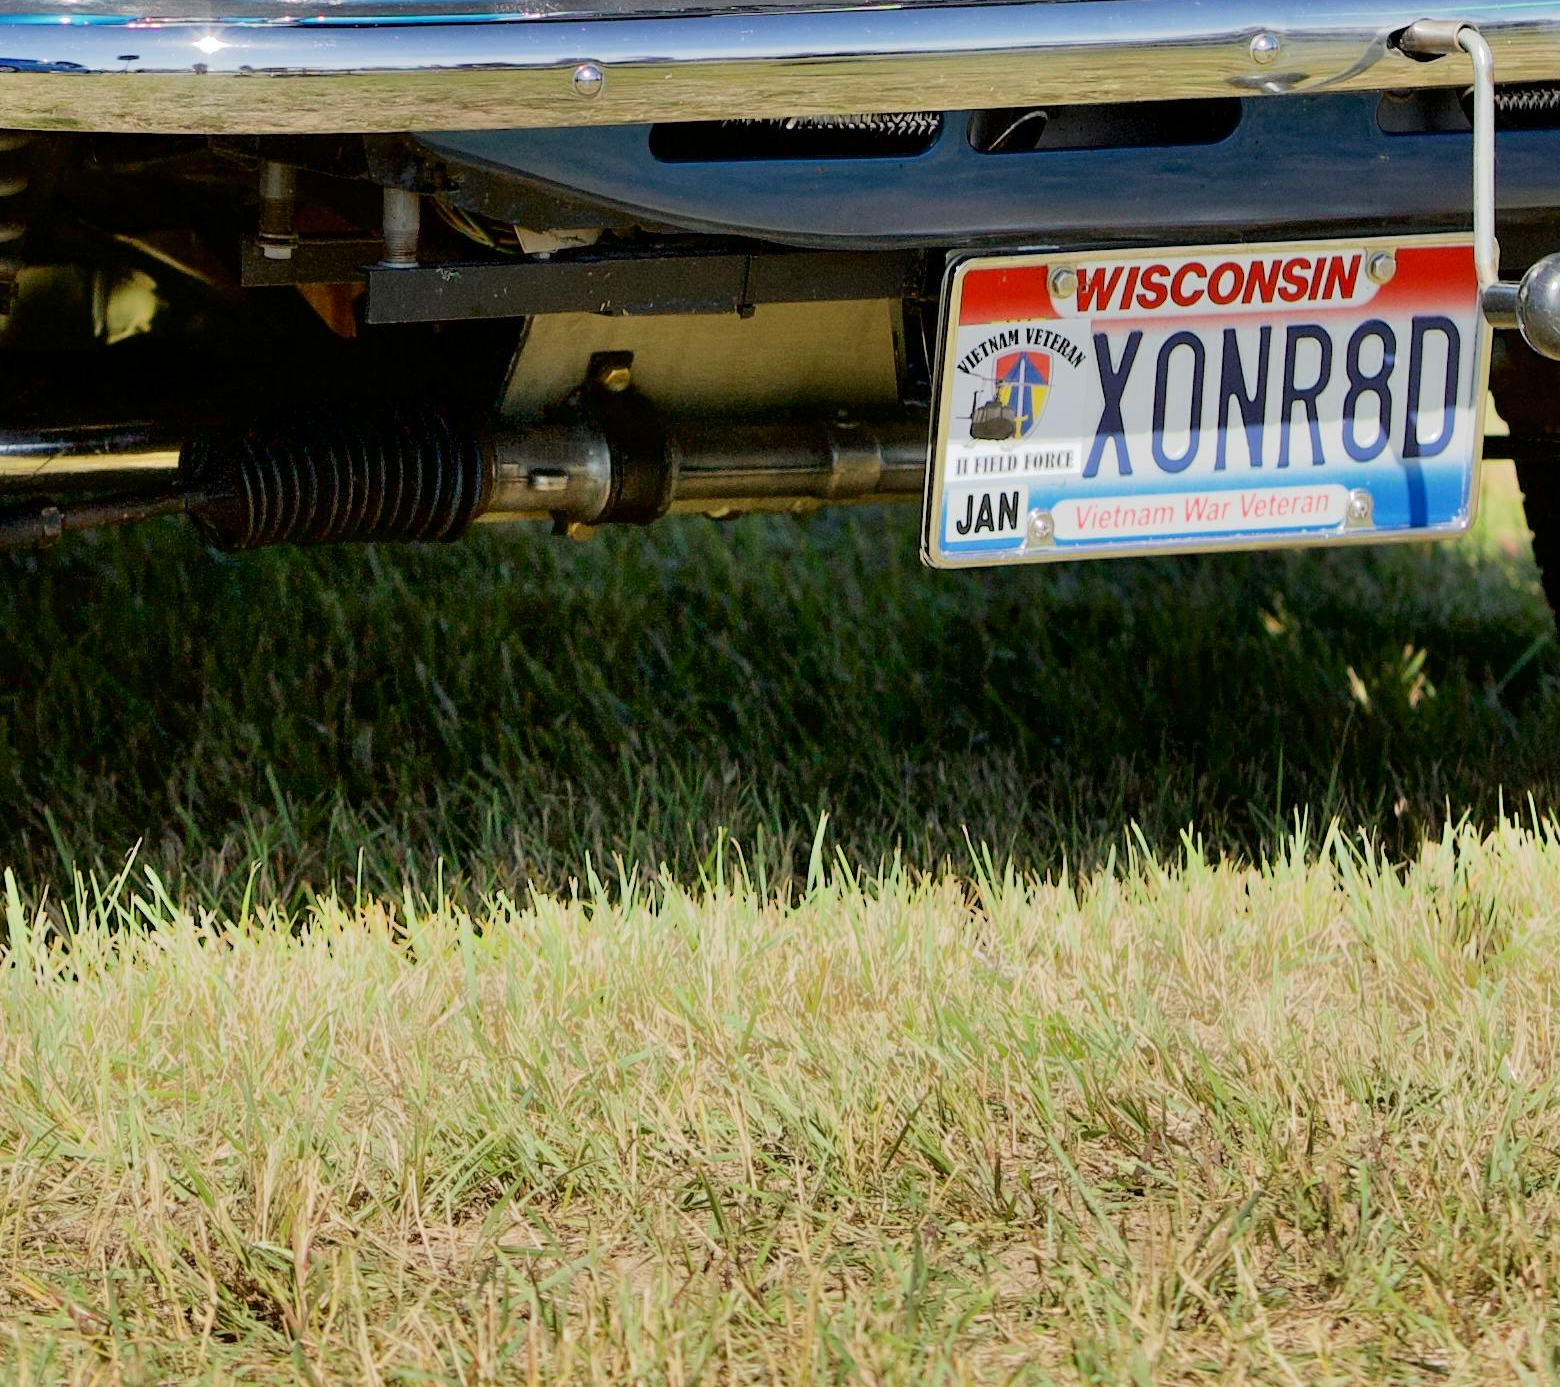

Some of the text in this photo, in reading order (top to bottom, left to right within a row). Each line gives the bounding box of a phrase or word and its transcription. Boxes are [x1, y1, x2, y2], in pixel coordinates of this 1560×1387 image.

[1075, 253, 1363, 313] WISCONSIN
[956, 327, 1087, 375] VIETNAM VETERAN
[956, 450, 1074, 476] II FIELD FORCE
[956, 490, 1020, 536] JAN
[1074, 493, 1329, 531] Vietnam War Veteran
